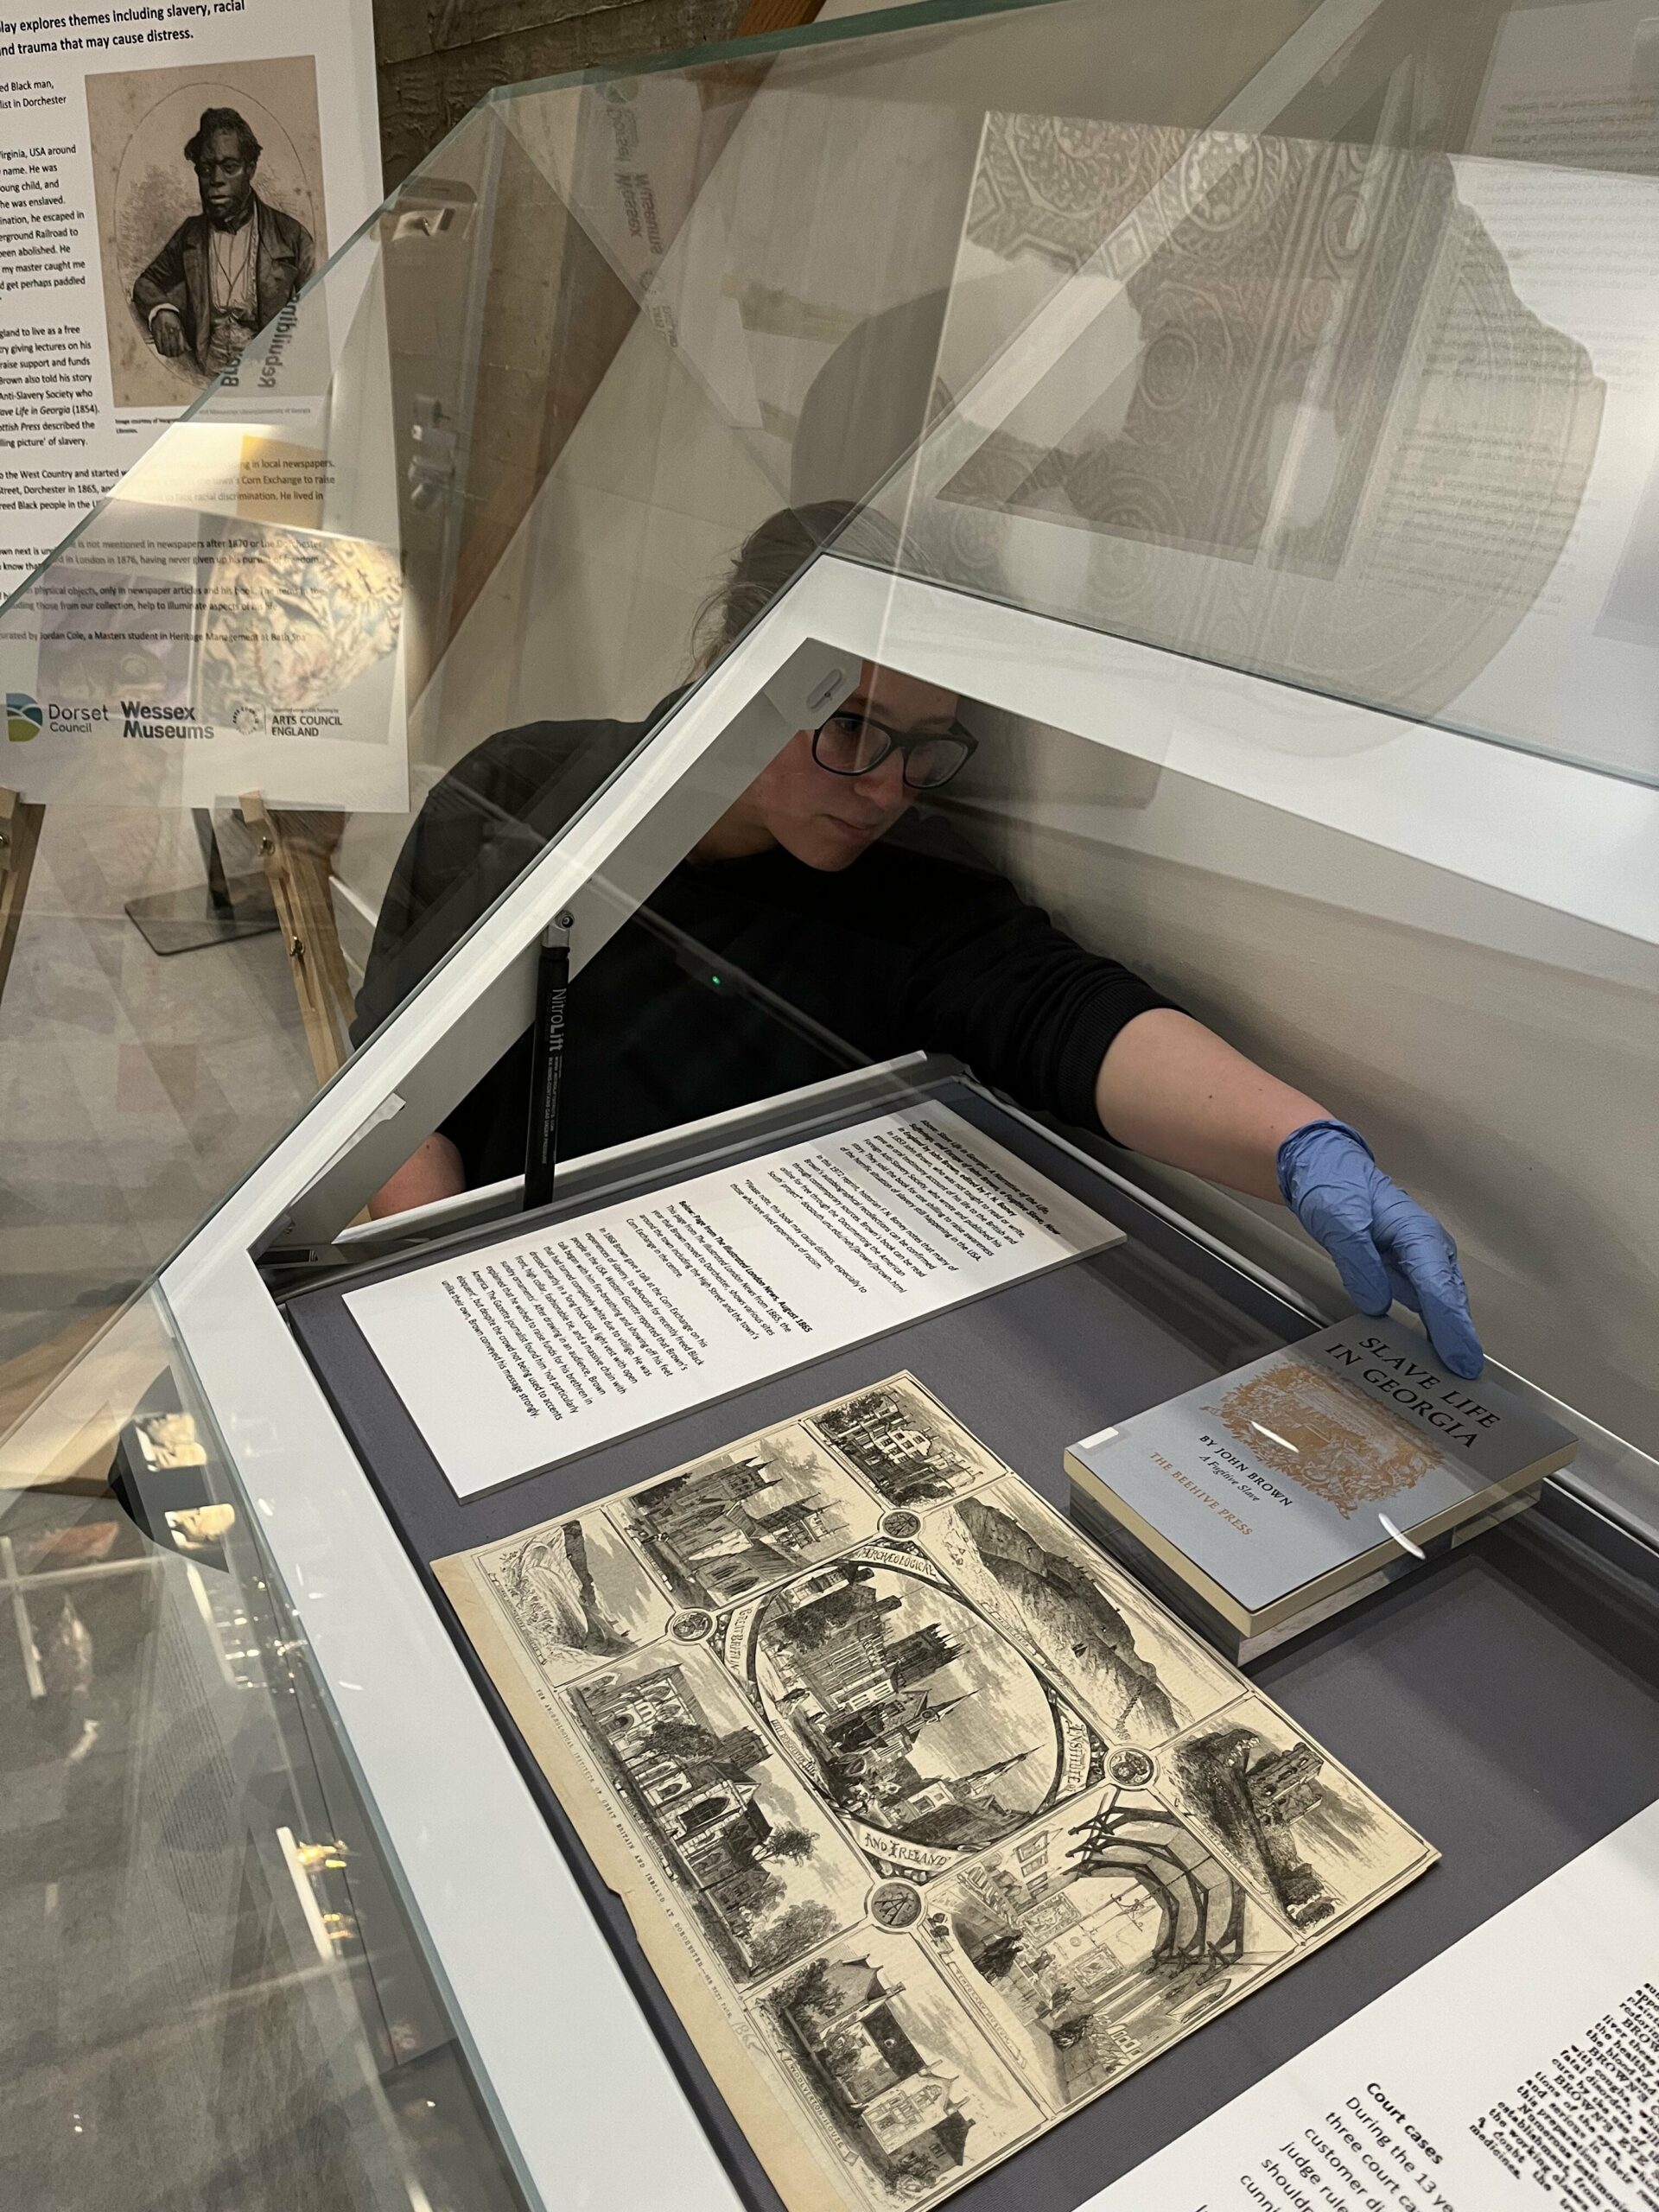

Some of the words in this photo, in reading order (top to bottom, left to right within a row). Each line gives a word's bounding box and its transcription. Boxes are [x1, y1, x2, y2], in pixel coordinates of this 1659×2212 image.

[0, 21, 16, 35] lay
[20, 16, 67, 33] explores
[68, 14, 111, 27] themes
[112, 7, 164, 22] including
[167, 4, 211, 17] slavery,
[213, 0, 245, 13] racial
[17, 41, 58, 54] trauma
[60, 38, 84, 51] that
[86, 37, 110, 49] may
[112, 34, 144, 46] cause
[147, 29, 194, 42] distress.
[10, 80, 32, 92] Black
[34, 80, 54, 89] man,
[13, 99, 22, 108] in
[22, 96, 67, 107] Dorchester
[29, 147, 47, 157] USA
[48, 144, 76, 156] around
[3, 167, 28, 175] name.
[29, 165, 40, 174] He
[29, 195, 66, 207] enslaved.
[30, 213, 41, 223] he
[42, 211, 75, 222] escaped
[35, 227, 68, 238] Railroad
[69, 228, 79, 237] to
[18, 245, 58, 256] abolished.
[59, 245, 71, 254] He
[2, 265, 14, 275] my
[16, 264, 42, 272] master
[44, 260, 71, 272] caught
[24, 375, 41, 384] also
[41, 374, 58, 384] told
[59, 373, 71, 382] his
[72, 374, 92, 383] story
[16, 406, 29, 417] Life
[40, 405, 71, 416] Georgia
[72, 404, 100, 416] (1854).
[16, 437, 46, 448] picture'
[48, 436, 56, 446] of
[58, 436, 88, 447] slavery.
[5, 471, 18, 480] the
[41, 469, 73, 480] Country
[74, 468, 89, 478] and
[91, 468, 119, 478] started
[261, 459, 281, 468] local
[283, 460, 335, 471] newspapers.
[23, 486, 66, 494] Dorchester
[67, 485, 75, 493] in
[78, 484, 99, 494] 1865,
[241, 475, 261, 485] Corn
[263, 475, 302, 486] Exchange
[315, 474, 335, 484] raise
[280, 491, 291, 500] He
[293, 491, 314, 500] lived
[315, 491, 324, 500] in
[48, 704, 109, 721] Dorset
[121, 702, 196, 721] Wessex
[50, 722, 92, 733] Council
[123, 720, 215, 740] Museums
[271, 715, 297, 727] ARTS
[300, 715, 343, 727] COUNCIL
[271, 727, 319, 738] ENGLAND
[678, 1200, 696, 1216] Below:
[693, 1215, 706, 1226] Page
[703, 1225, 717, 1237] from
[715, 1236, 726, 1246] The
[745, 1268, 766, 1287] London
[763, 1286, 779, 1301] News,
[778, 1301, 799, 1319] August
[795, 1319, 813, 1332] 1865
[613, 1243, 629, 1258] Brown
[624, 1258, 639, 1269] gave
[639, 1272, 651, 1282] talk
[652, 1287, 662, 1296] the
[670, 1307, 693, 1332] Exchange
[697, 1338, 708, 1348] his
[442, 1281, 455, 1295] unlike
[451, 1294, 464, 1306] their
[460, 1307, 471, 1320] own,
[468, 1319, 484, 1336] Brown
[480, 1336, 503, 1361] conveyed
[497, 1360, 507, 1370] his
[504, 1369, 523, 1394] message
[518, 1393, 540, 1418] strongly.
[1359, 1336, 1439, 1389] SLAVE
[1440, 1389, 1501, 1430] LIFE
[1325, 1343, 1360, 1368] IN
[1363, 1366, 1478, 1449] GEORGIA
[1199, 1434, 1217, 1445] BY
[1213, 1444, 1248, 1472] JOHN
[1247, 1471, 1293, 1507] BROWN
[1199, 1453, 1210, 1462] A
[1206, 1459, 1241, 1489] Fugitive
[1236, 1484, 1261, 1503] Slave
[1149, 1452, 1172, 1470] THE
[1172, 1470, 1220, 1512] BEEHIVE
[1217, 1510, 1253, 1537] PRESS
[865, 1833, 887, 1852] AND
[1585, 2030, 1605, 2049] the
[1516, 2085, 1538, 2107] this
[1367, 2082, 1407, 2124] Court
[1404, 2124, 1444, 2164] cases
[1345, 2097, 1393, 2148] During
[1390, 2145, 1416, 2173] the
[1414, 2173, 1438, 2194] 13
[1488, 2108, 1507, 2127] the
[1510, 2129, 1552, 2174] working
[1304, 2128, 1369, 2196] customer
[1325, 2112, 1363, 2152] three
[1362, 2152, 1401, 2195] court
[1279, 2141, 1322, 2186] judge
